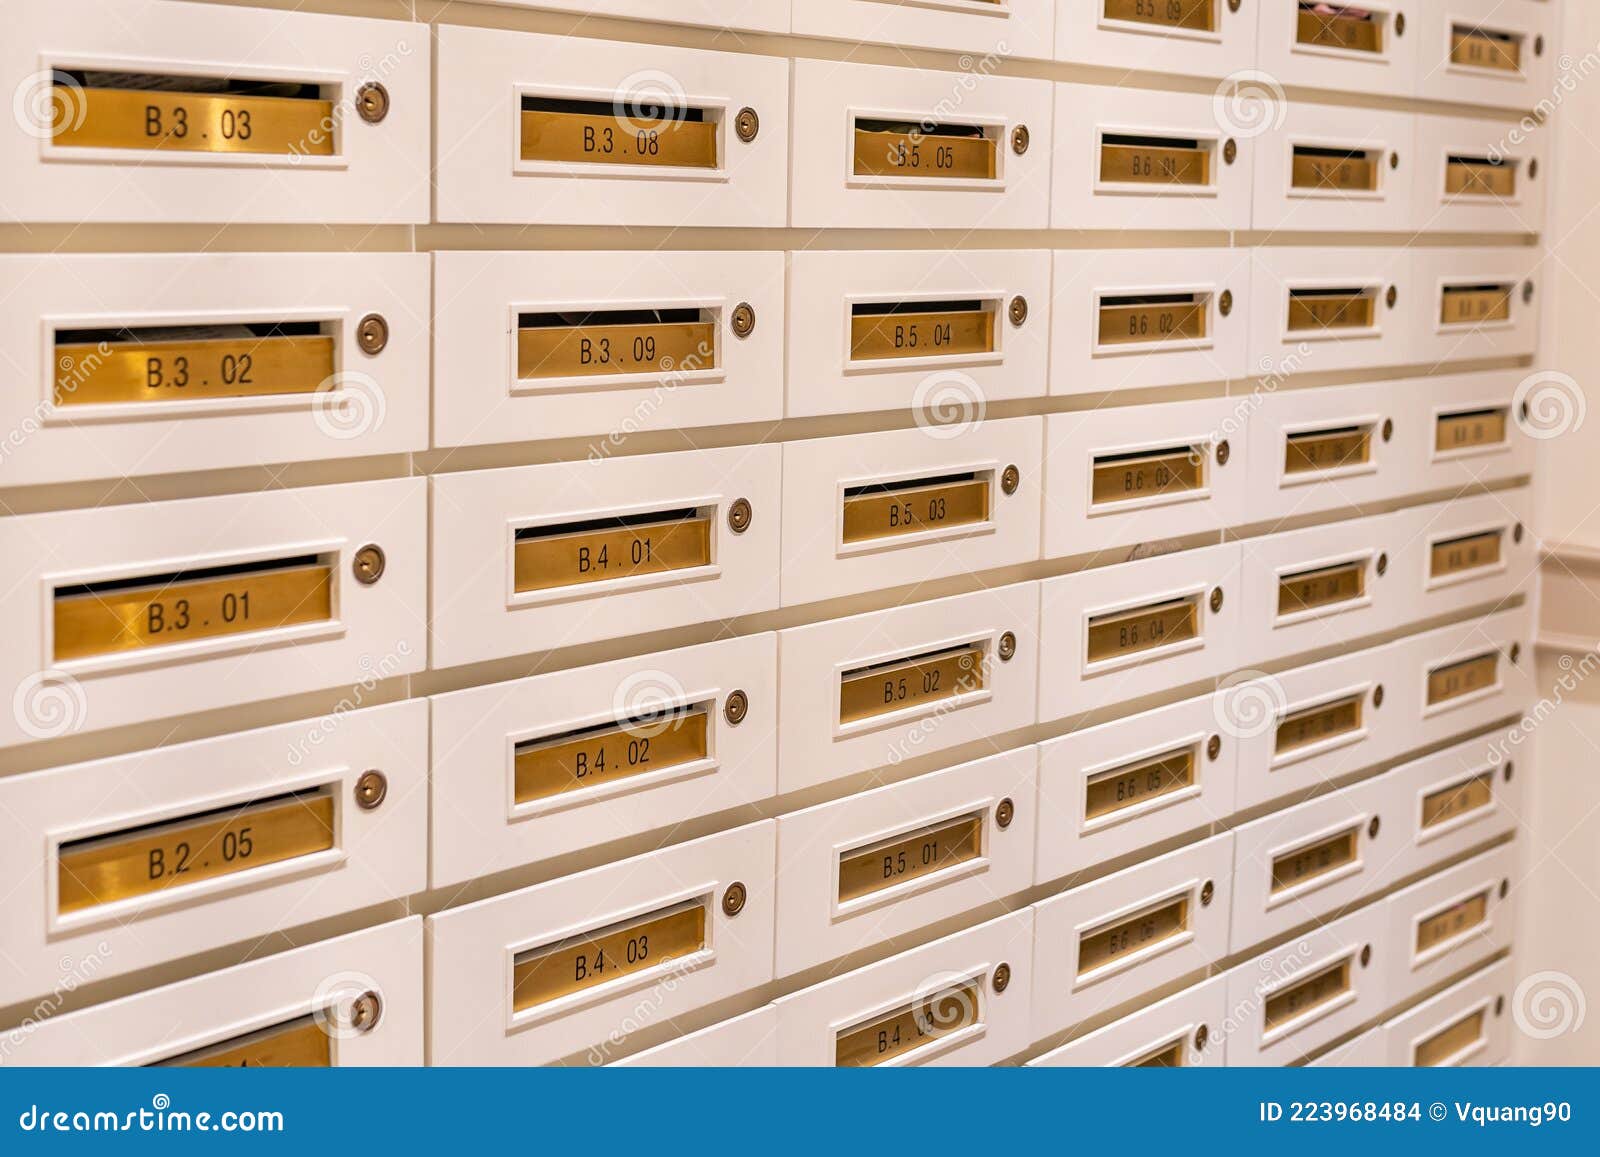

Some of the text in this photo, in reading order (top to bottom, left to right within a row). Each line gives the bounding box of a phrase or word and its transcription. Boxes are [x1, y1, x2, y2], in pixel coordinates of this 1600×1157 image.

[146, 105, 188, 138] B.3
[221, 109, 251, 140] 03
[584, 126, 613, 153] B.3
[637, 129, 659, 155] 08
[897, 144, 920, 168] B.5
[936, 146, 953, 169] 05
[895, 325, 917, 348] B.5
[934, 323, 951, 346] 04
[1160, 312, 1173, 333] 02
[580, 338, 610, 364] B.3
[633, 336, 655, 362] 09
[147, 356, 189, 388] B.3
[221, 354, 253, 384] 02
[890, 503, 912, 527] B.5
[929, 498, 945, 521] 03
[579, 544, 608, 573] B.4
[631, 538, 651, 565] 01
[148, 600, 190, 634] B.3
[222, 591, 249, 623] 01
[885, 679, 906, 704] B.5
[923, 670, 940, 693] 02
[576, 748, 605, 778] B.4
[628, 738, 650, 765] 02
[149, 842, 190, 879] B.2
[222, 828, 252, 861] 05
[884, 852, 906, 878] B.5
[922, 841, 938, 865] 01
[575, 949, 605, 981] B.4
[627, 936, 648, 964] 03
[878, 1024, 900, 1053] B.4
